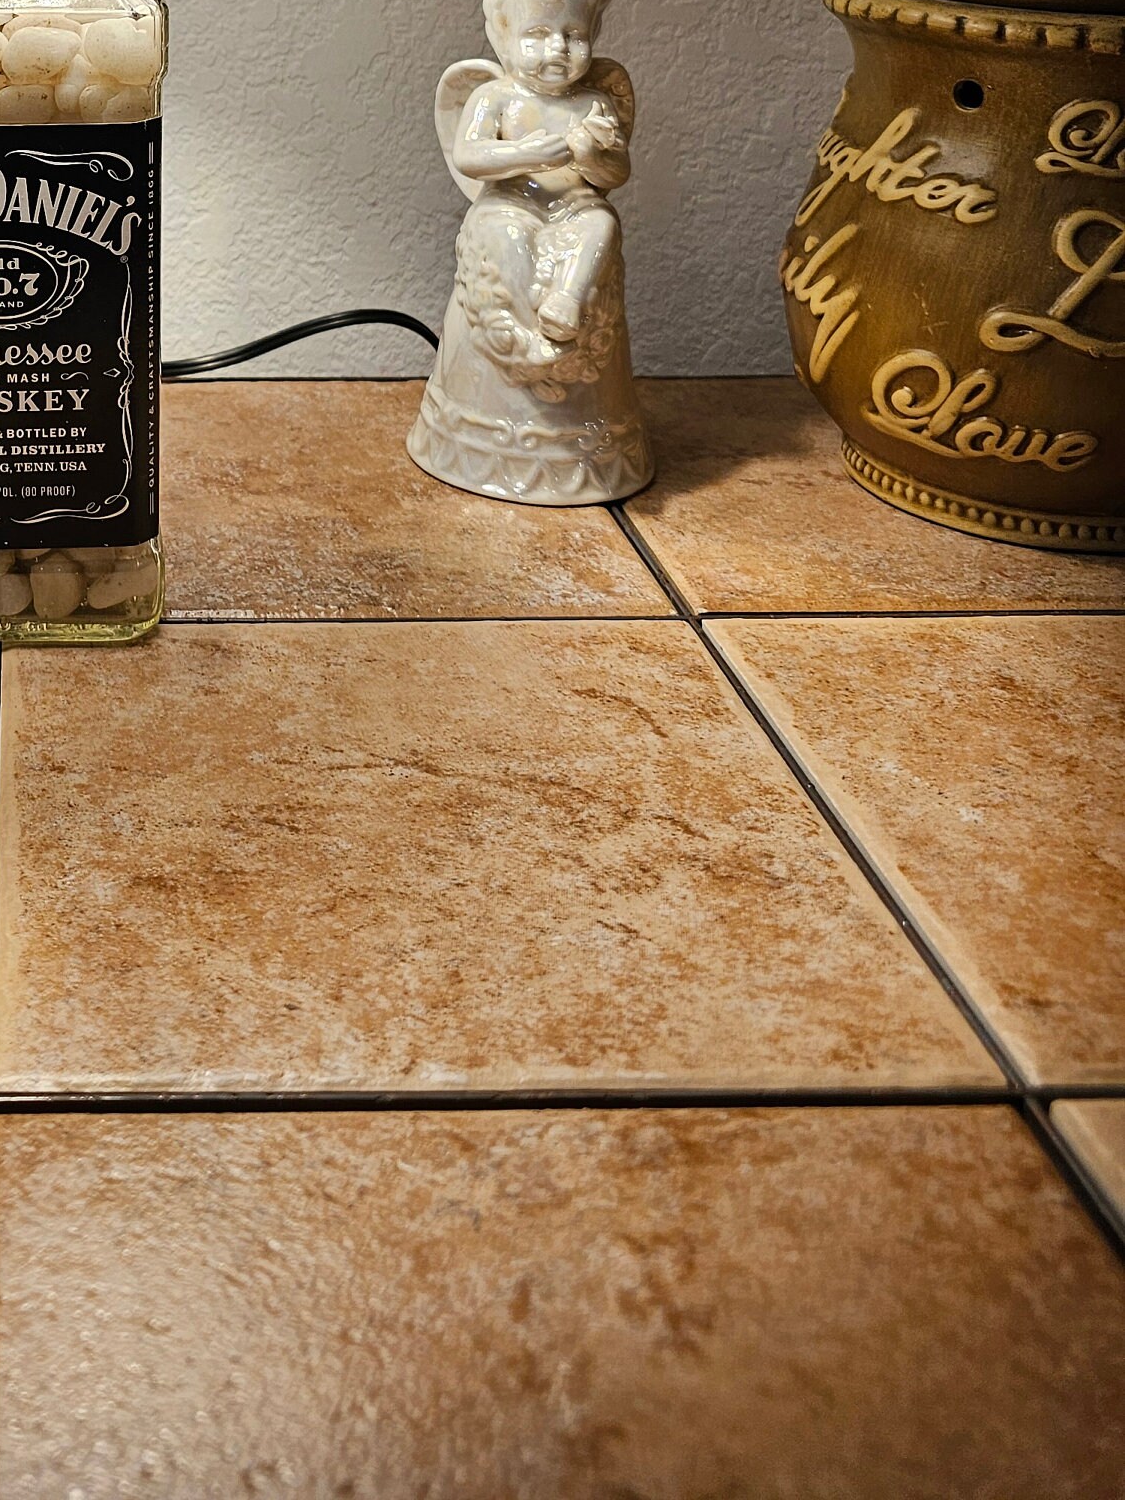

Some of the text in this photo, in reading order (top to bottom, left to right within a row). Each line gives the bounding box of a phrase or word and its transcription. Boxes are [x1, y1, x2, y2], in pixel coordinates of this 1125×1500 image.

[6, 373, 50, 384] MASH
[863, 349, 1099, 472] Love
[6, 427, 67, 439] BOTTLED
[70, 426, 87, 438] BY
[11, 443, 106, 456] DISTILLERY
[14, 462, 58, 473] TENN.
[60, 461, 87, 472] USA
[21, 486, 37, 498] (80
[40, 485, 76, 497] PROOF)
